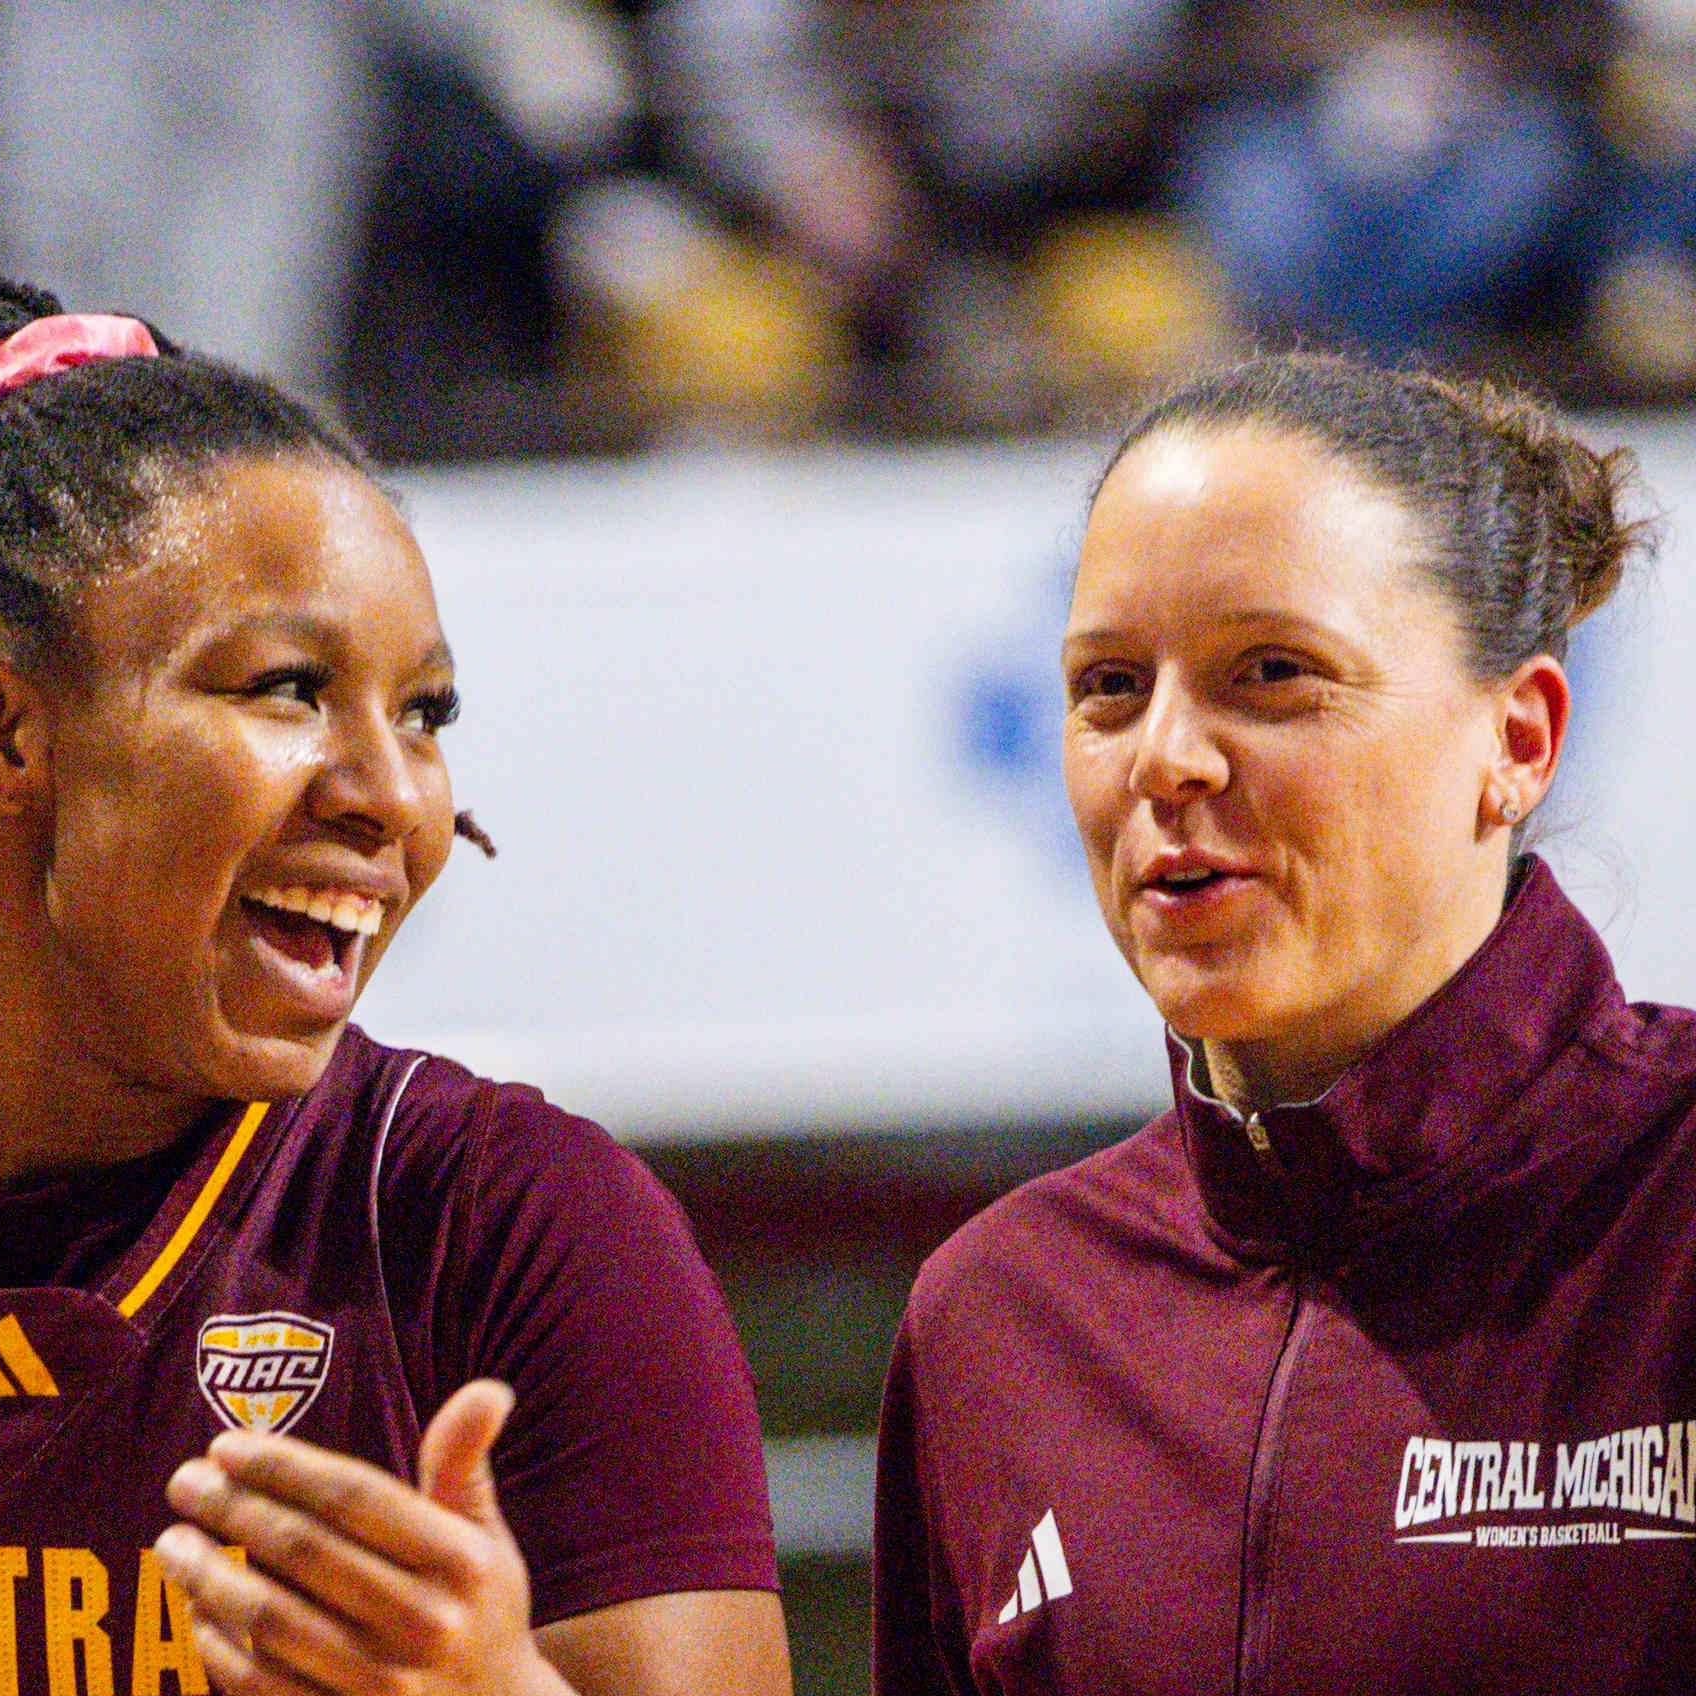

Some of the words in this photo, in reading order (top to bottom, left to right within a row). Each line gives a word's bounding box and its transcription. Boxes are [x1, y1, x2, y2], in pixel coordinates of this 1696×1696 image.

[202, 1354, 321, 1388] MAC
[1395, 1436, 1545, 1530] CENTRAL
[1475, 1525, 1538, 1547] WOMEN'S
[1540, 1522, 1621, 1547] BASKETBALL
